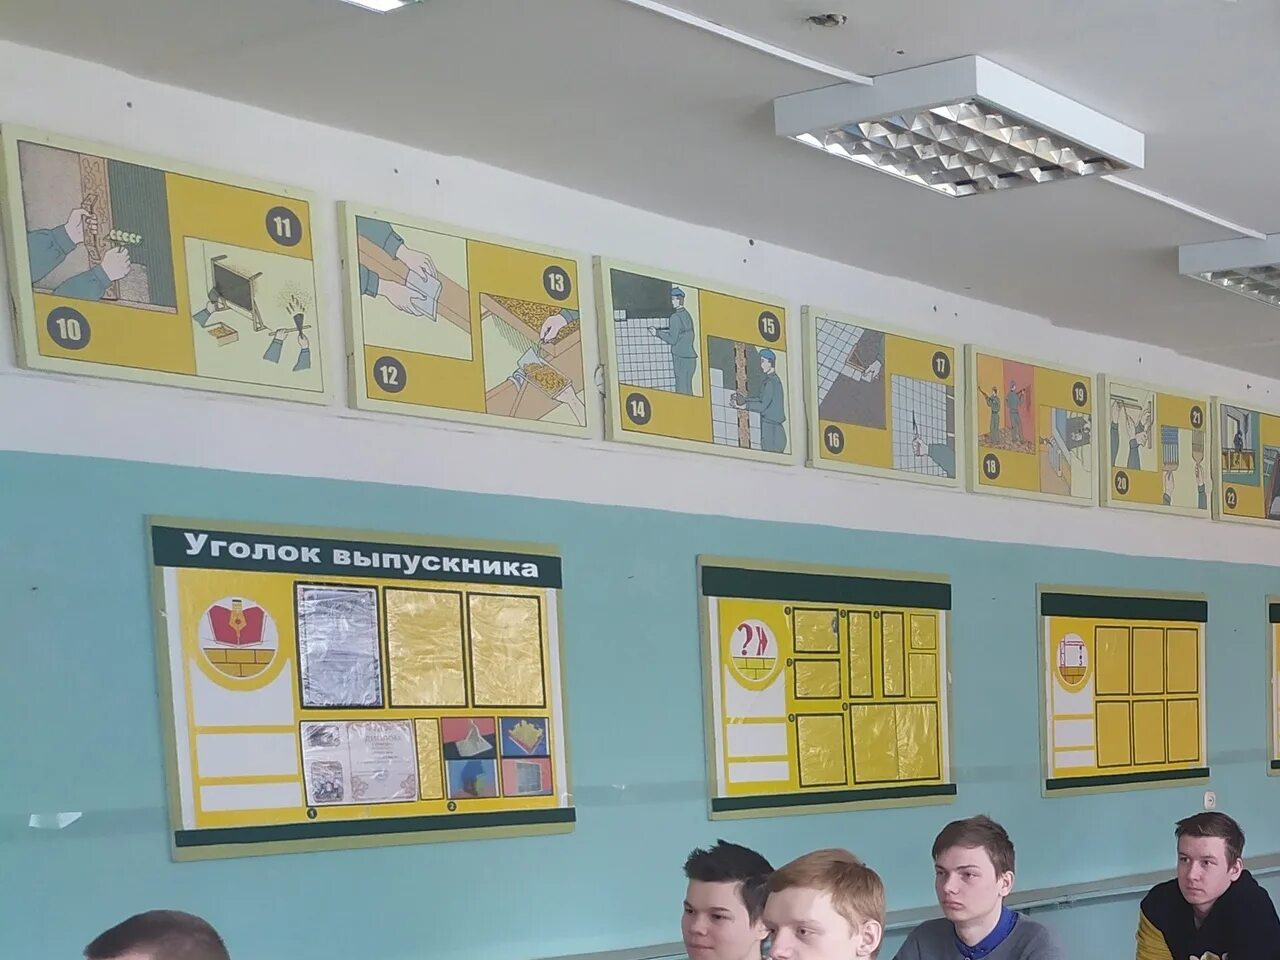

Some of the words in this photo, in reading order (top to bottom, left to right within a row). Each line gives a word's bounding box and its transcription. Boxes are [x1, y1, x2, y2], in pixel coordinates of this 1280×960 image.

[273, 216, 291, 237] 11
[549, 273, 565, 292] 13
[56, 318, 81, 341] 10
[762, 318, 774, 333] 15
[936, 358, 946, 372] 17
[380, 366, 399, 385] 12
[1075, 388, 1084, 401] 19
[631, 401, 645, 417] 14
[1193, 411, 1201, 423] 21
[828, 433, 839, 448] 16
[986, 460, 996, 474] 18
[1117, 477, 1126, 489] 20
[184, 532, 323, 565] Уголок
[333, 548, 540, 579] выпускника
